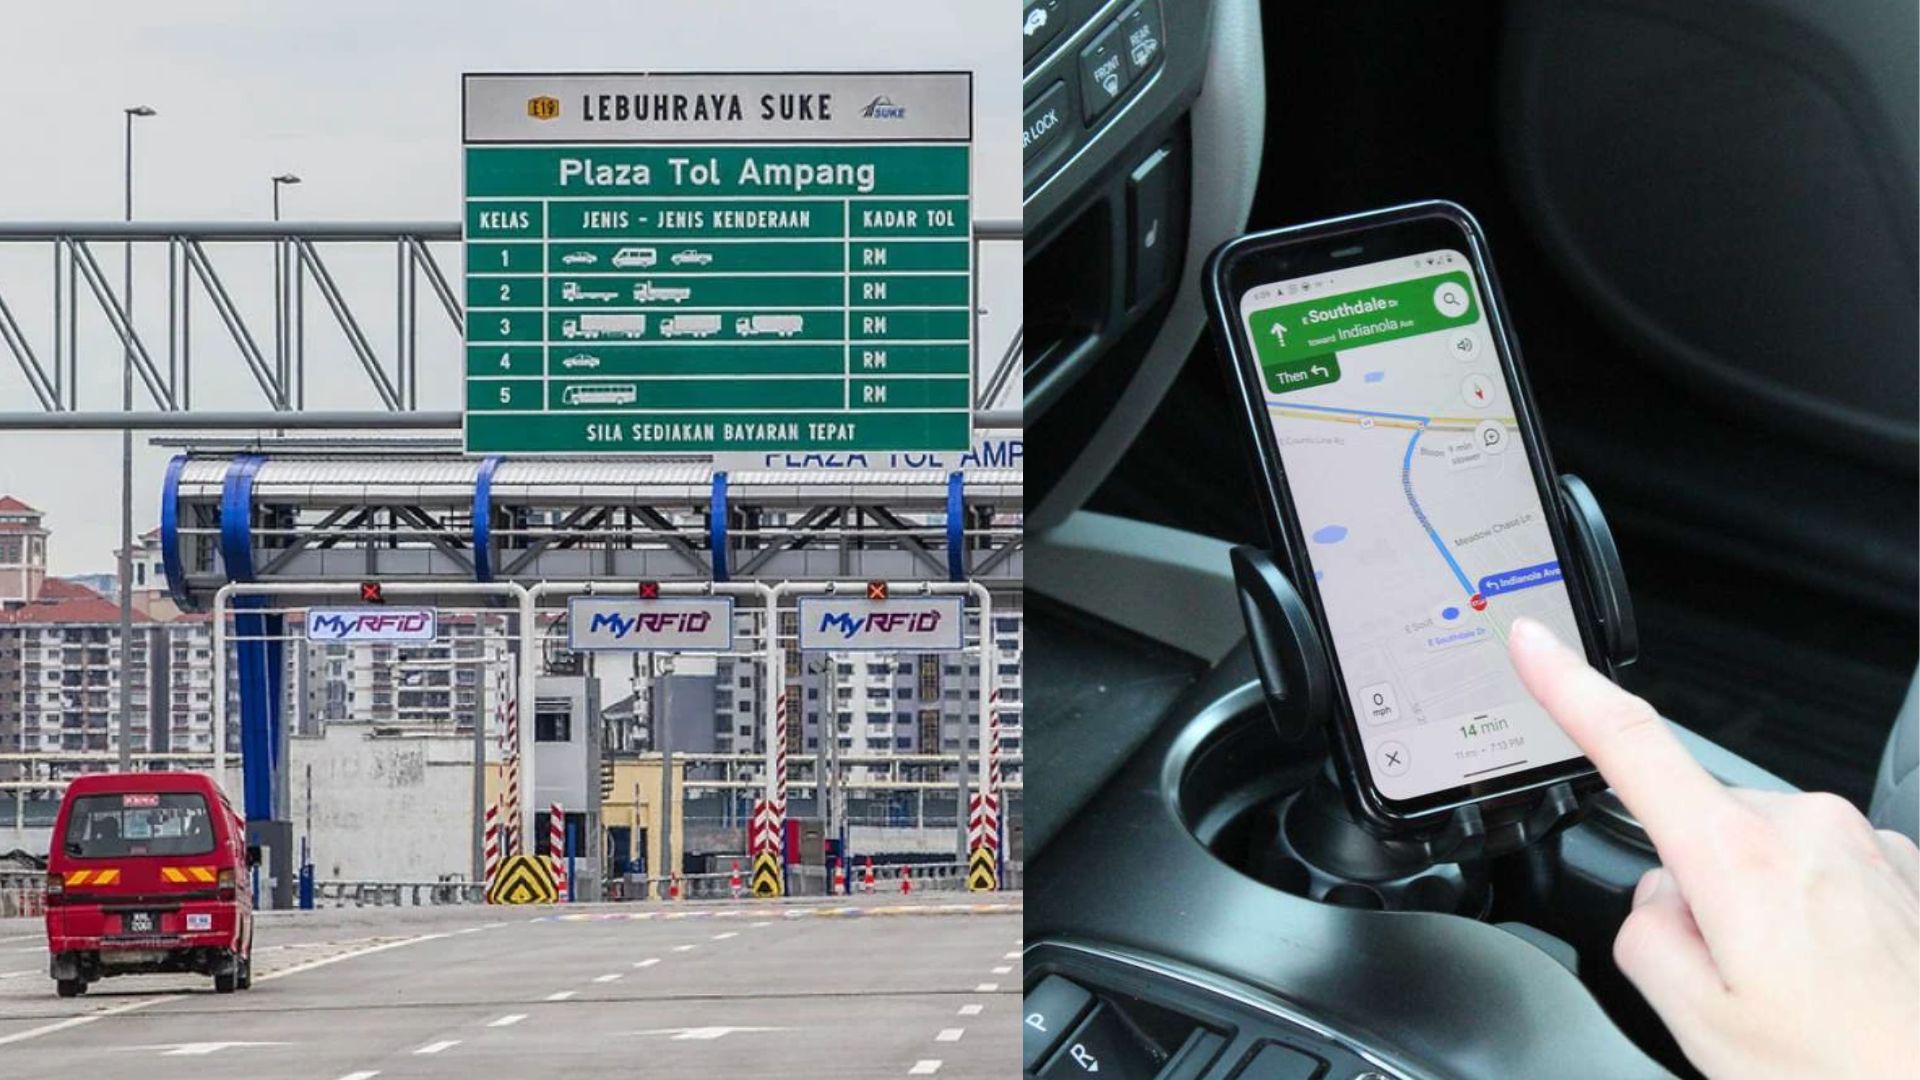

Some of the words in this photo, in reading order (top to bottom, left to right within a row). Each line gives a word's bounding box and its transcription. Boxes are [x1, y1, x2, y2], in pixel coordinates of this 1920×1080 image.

[1129, 24, 1151, 47] REAR
[1093, 55, 1121, 83] FRONT
[583, 95, 743, 121] LEBUHRAYA
[760, 94, 832, 121] SUKE
[873, 107, 906, 119] SUKE
[1032, 109, 1059, 140] LOCK
[559, 158, 650, 187] Plaza
[668, 158, 720, 187] Tol
[739, 158, 875, 193] Ampang
[480, 211, 530, 230] KELAS
[582, 211, 632, 229] JENIS
[656, 211, 704, 229] JENIS
[712, 210, 811, 229] KENDERAAN
[863, 210, 918, 229] KADAR
[926, 209, 956, 228] TOL
[500, 248, 511, 267] 1
[862, 248, 887, 265] RM
[500, 283, 511, 302] 2
[862, 283, 887, 300] RM
[1308, 297, 1387, 323] Southdale
[500, 317, 511, 336] 3
[862, 317, 887, 334] RM
[1338, 318, 1399, 340] Indianola
[500, 351, 511, 370] 4
[862, 351, 887, 368] RM
[1276, 370, 1308, 385] Then
[500, 385, 511, 404] 5
[862, 385, 887, 402] RM
[586, 424, 624, 442] SILA
[632, 423, 715, 442] SEDIAKAN
[723, 423, 800, 442] BAYARAN
[808, 423, 856, 442] TEPAT
[1454, 528, 1492, 548] Meadow
[1499, 571, 1542, 588] Indianola
[1373, 693, 1384, 706] 0
[1372, 706, 1392, 717] mph
[1460, 724, 1477, 738] 14
[1480, 717, 1509, 732] min
[1509, 736, 1525, 748] PM
[1025, 1013, 1048, 1032] P
[1070, 1043, 1095, 1069] R
